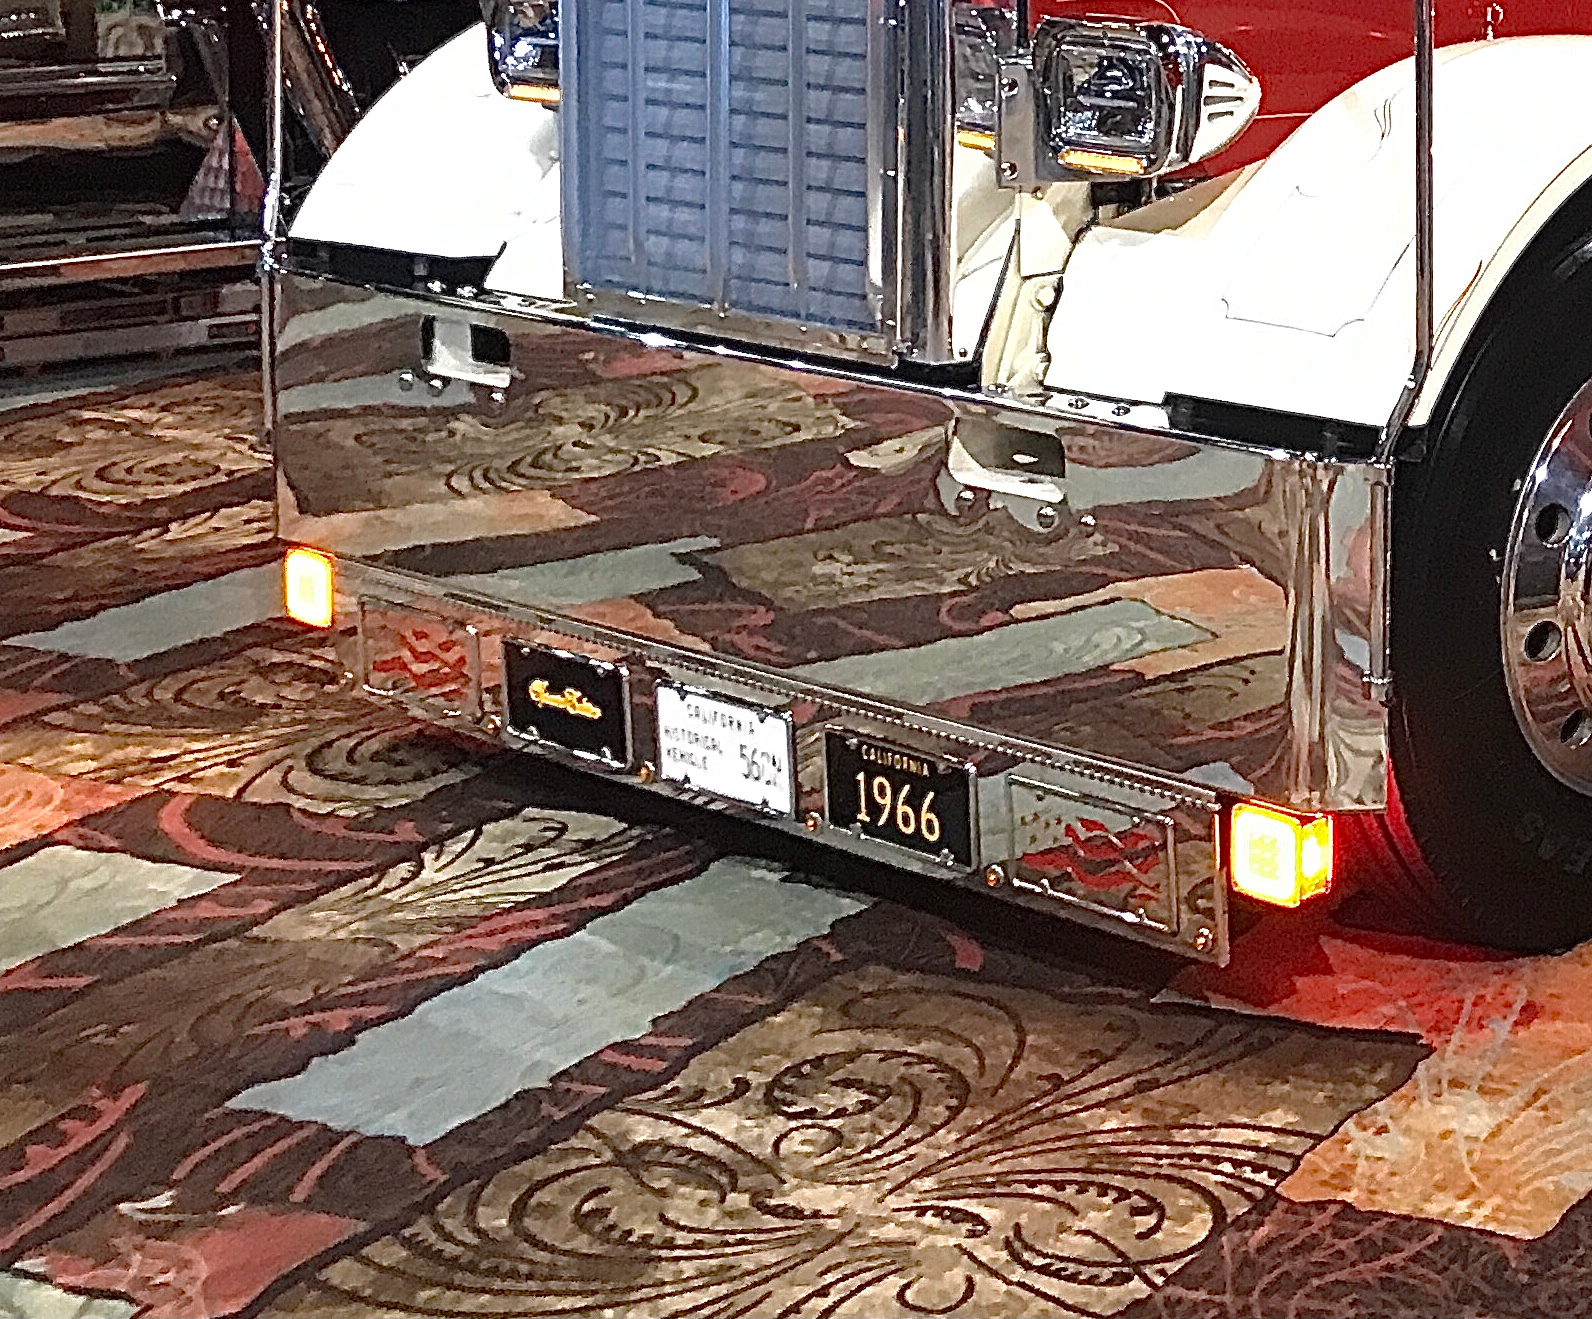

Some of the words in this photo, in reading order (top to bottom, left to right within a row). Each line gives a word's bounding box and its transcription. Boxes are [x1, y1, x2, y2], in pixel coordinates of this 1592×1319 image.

[686, 703, 756, 735] CALIFORNIA
[861, 744, 930, 778] CALIFORNIA
[855, 771, 941, 842] 1966
